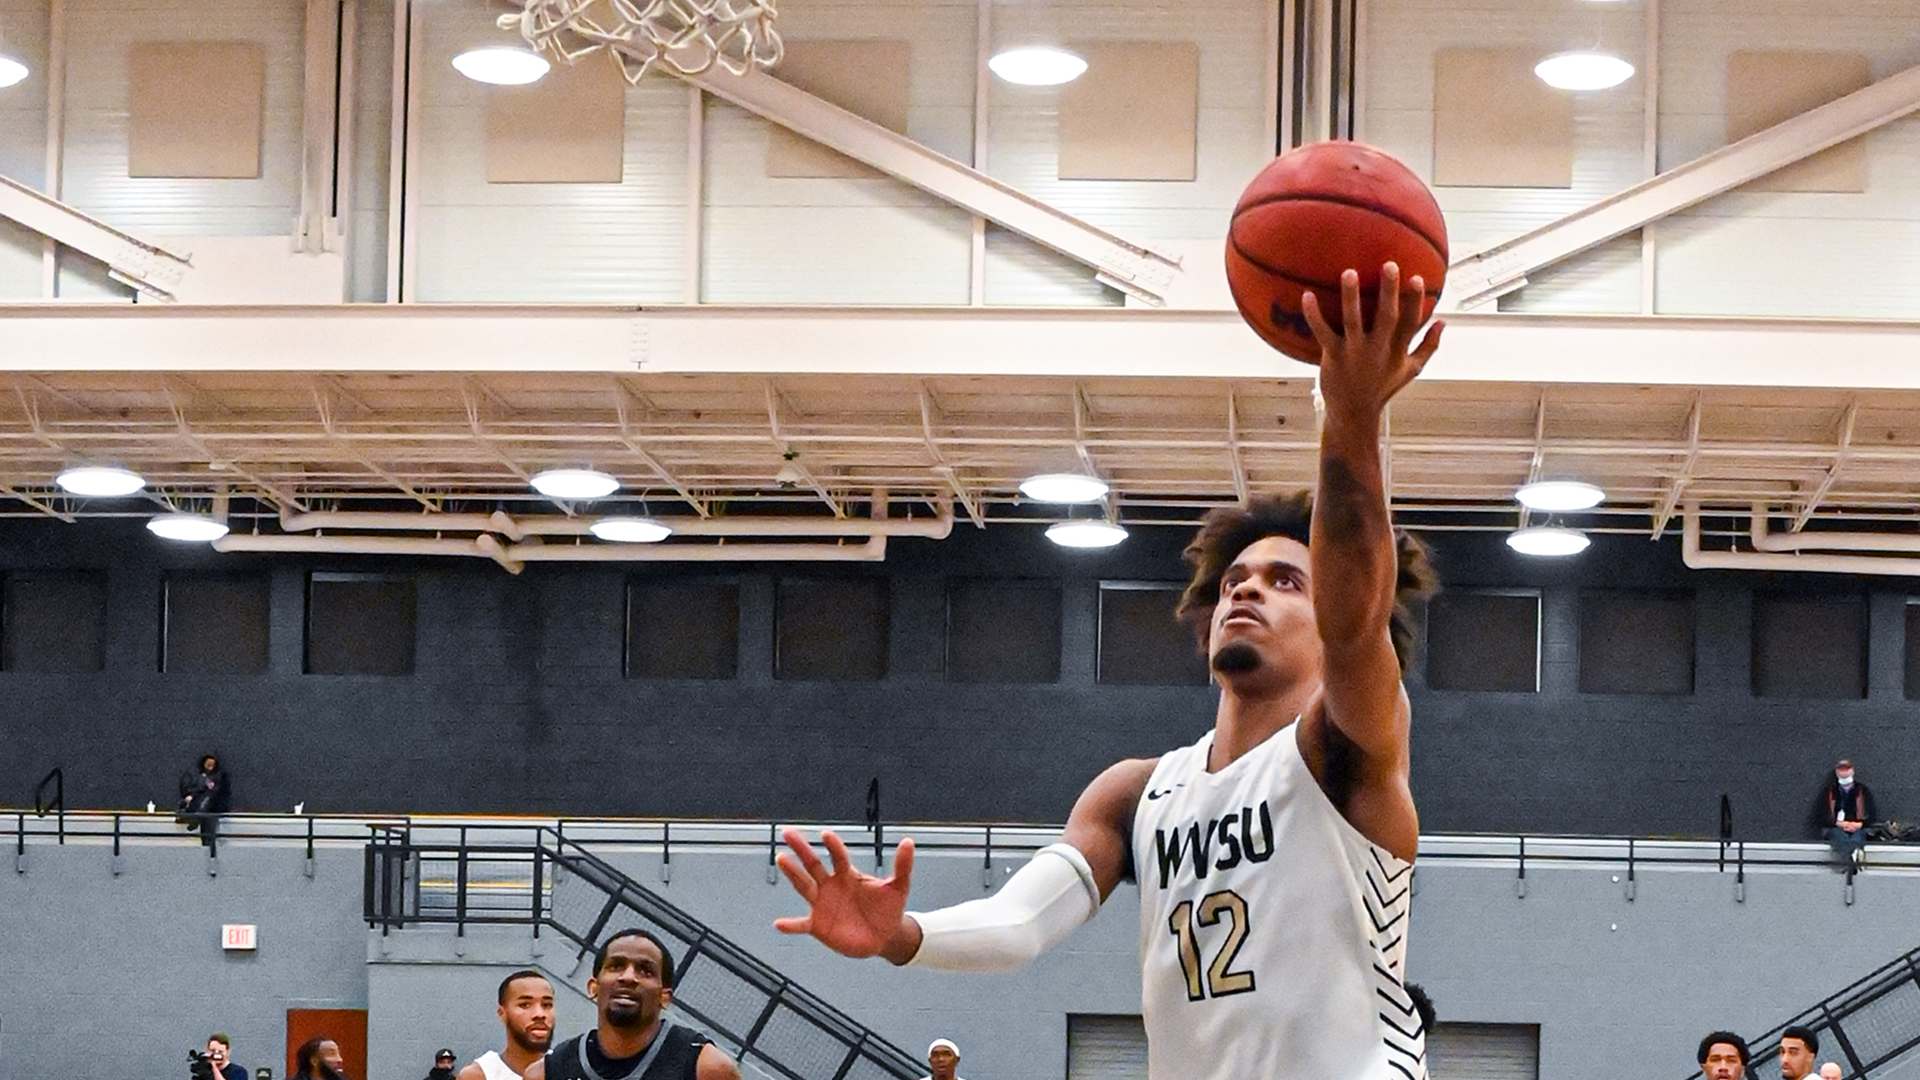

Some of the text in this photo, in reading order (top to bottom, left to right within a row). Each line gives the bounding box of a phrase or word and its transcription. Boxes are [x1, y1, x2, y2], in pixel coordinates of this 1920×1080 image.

[1156, 800, 1275, 889] WVSU
[228, 929, 250, 945] EXIT
[1168, 889, 1256, 1002] 12
